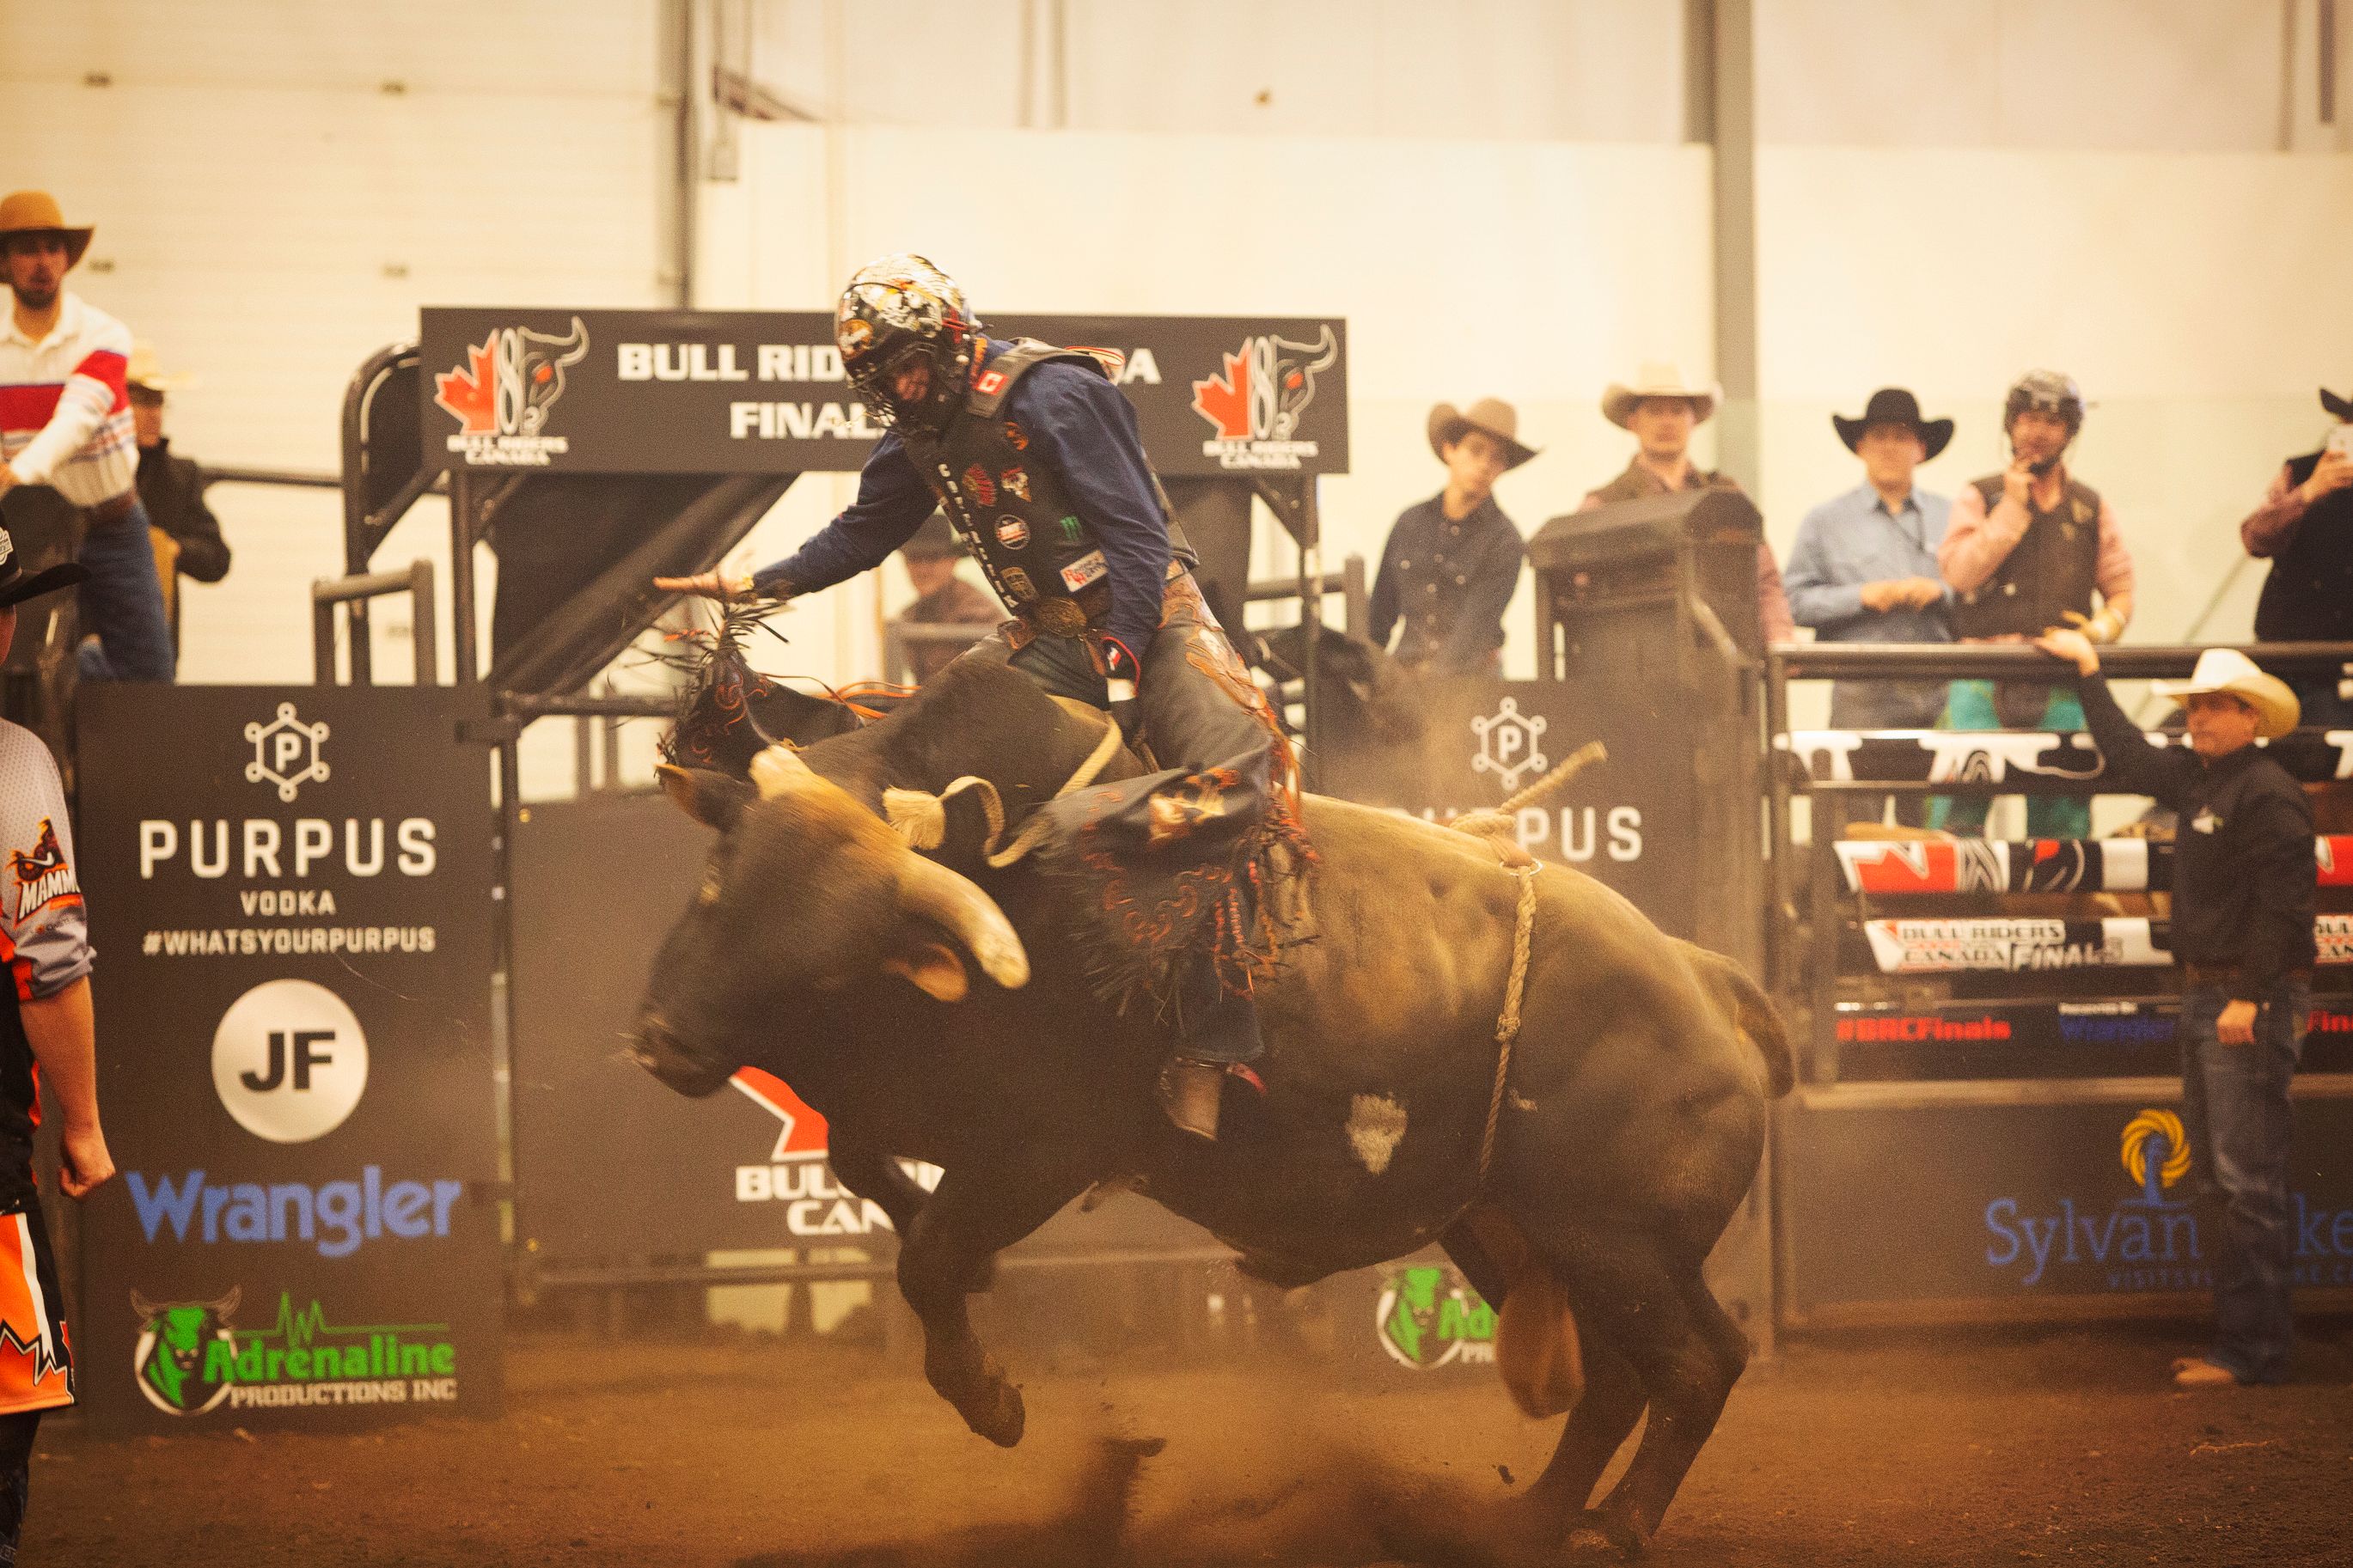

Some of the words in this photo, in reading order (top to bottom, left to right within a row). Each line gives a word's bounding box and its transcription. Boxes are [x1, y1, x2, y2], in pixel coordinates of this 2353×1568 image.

[617, 343, 749, 381] BULL
[757, 344, 849, 382] RID
[730, 401, 887, 439] FINAL
[275, 731, 303, 773] P
[1498, 724, 1523, 762] P
[139, 817, 437, 879] PURPUS
[19, 869, 82, 919] MAMM
[240, 889, 337, 917] VODKA
[142, 925, 436, 956] #WHATSYOURPURPUS
[239, 1030, 336, 1095] JF
[125, 1164, 462, 1260] Wrangler
[786, 1198, 895, 1236] CAN
[1983, 1198, 2203, 1286] Sylvan
[2292, 1193, 2353, 1258] ke
[204, 1334, 455, 1384] Adrenaline
[230, 1379, 407, 1409] PRODUCTIONS
[412, 1377, 458, 1401] INC
